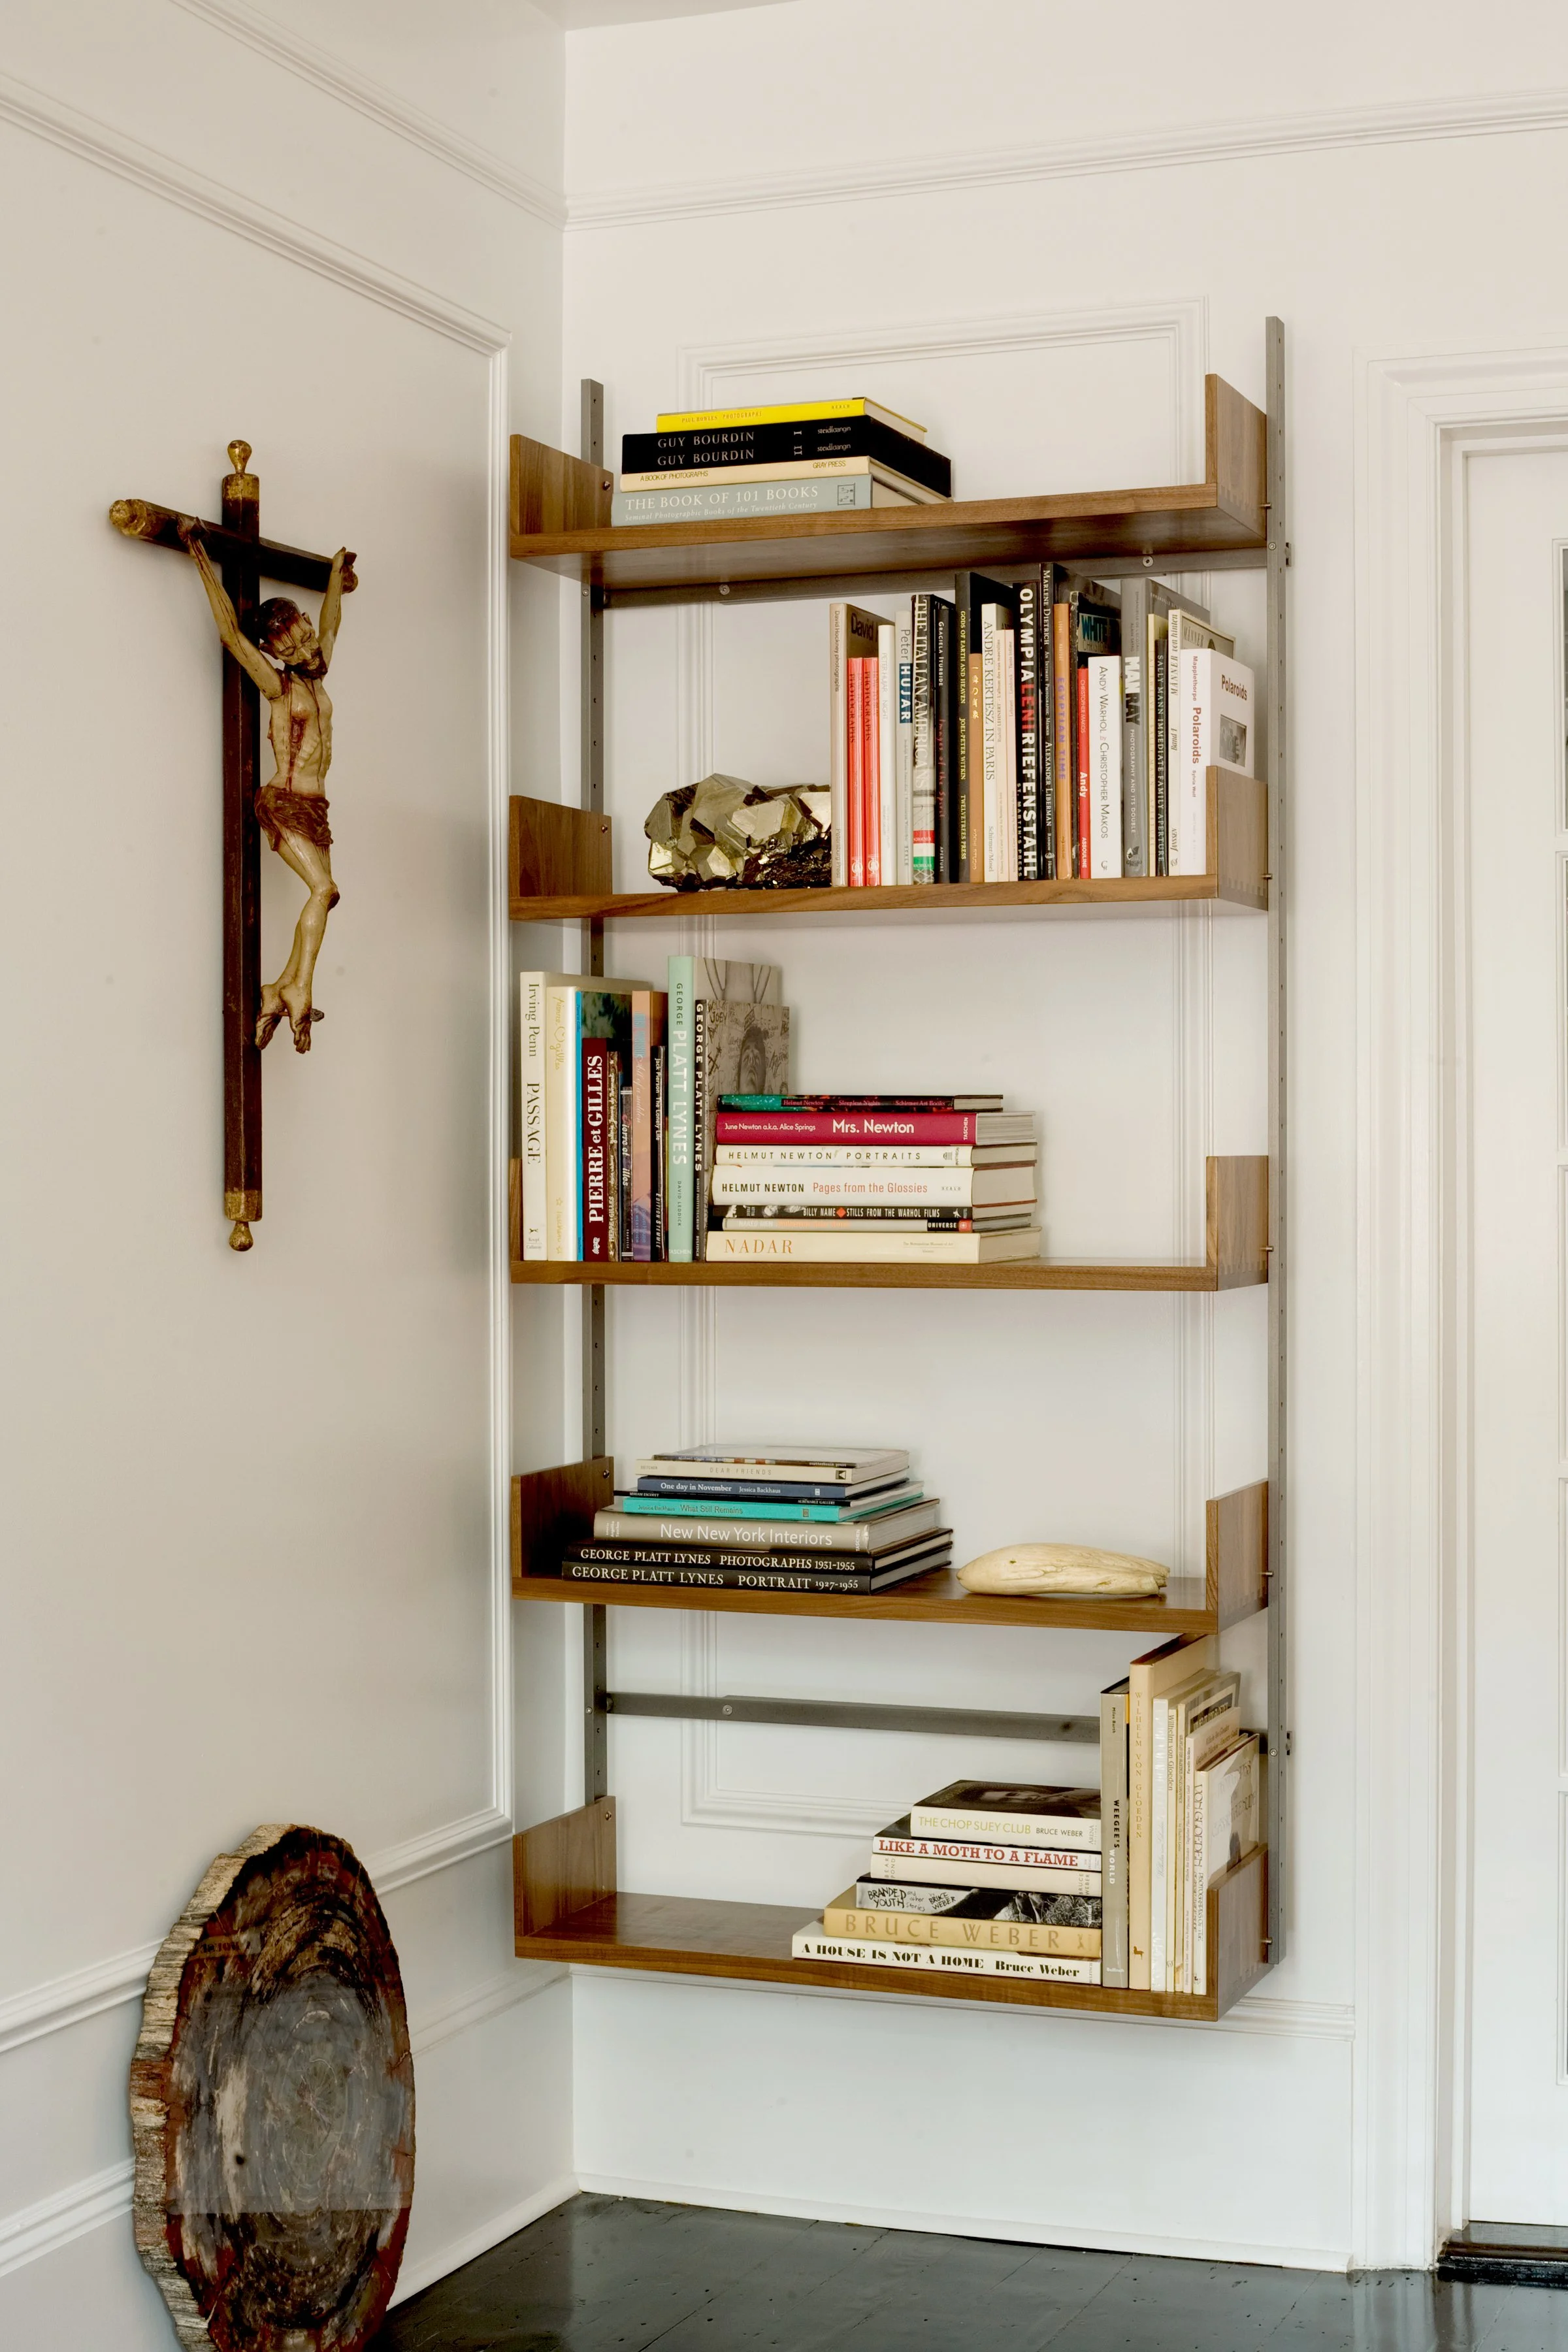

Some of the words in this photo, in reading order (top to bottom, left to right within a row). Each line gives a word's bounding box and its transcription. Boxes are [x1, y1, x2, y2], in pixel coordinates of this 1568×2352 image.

[657, 436, 685, 449] GUY
[693, 431, 755, 446] BOURDIN
[657, 454, 685, 466] GUY
[693, 449, 755, 463] BOURDIN
[669, 470, 708, 479] PHOTOGRAPHS
[625, 498, 655, 510] THE
[661, 494, 703, 508] BOOK
[710, 492, 729, 504] OF
[736, 491, 758, 502] 101
[767, 485, 818, 500] BOOKS
[851, 613, 874, 642] David
[915, 600, 928, 631] THE
[900, 629, 911, 660] Peter
[960, 630, 966, 639] OF
[1021, 589, 1034, 681] OLYMPIA
[915, 635, 928, 696] ITALIAN
[1099, 666, 1109, 691] ANDY
[1125, 657, 1140, 693] MAN
[901, 666, 911, 720] HUJAR
[1221, 674, 1247, 701] Polaroids
[1021, 683, 1036, 730] LENI
[1100, 694, 1109, 733] WARHOL
[1126, 693, 1140, 725] RAY
[915, 700, 928, 788] AMERICANS
[1192, 707, 1201, 764] Polaroids
[1080, 772, 1088, 798] Andy
[1100, 742, 1109, 801] CHRISTOPHER
[1022, 732, 1037, 876] RIEFENSTAHL
[1100, 804, 1109, 838] MAKOS
[525, 983, 541, 1021] Irving
[528, 1025, 541, 1057] Penn
[673, 1030, 687, 1092] PLATT
[587, 1056, 603, 1127] GILLES
[527, 1082, 541, 1165] PASSAGE
[593, 1130, 602, 1143] et
[672, 1102, 687, 1165] LYNES
[794, 1123, 816, 1133] Springs
[833, 1119, 860, 1134] Mrs.
[864, 1119, 915, 1134] Newton
[781, 1152, 832, 1160] NEWTON
[847, 1152, 921, 1160] PORTRAITS
[588, 1146, 604, 1223] PIERRE
[722, 1183, 760, 1192] HELMUT
[764, 1183, 804, 1193] NEWTON
[813, 1183, 841, 1195] Pages
[844, 1182, 866, 1193] from
[868, 1182, 884, 1193] the
[887, 1182, 928, 1194] Glossies
[803, 1207, 818, 1217] BILLY
[820, 1207, 836, 1217] NAME
[846, 1207, 864, 1217] STILLS
[866, 1207, 882, 1217] FROM
[885, 1208, 895, 1217] THE
[898, 1208, 922, 1218] WARHOL
[924, 1208, 940, 1218] FILMS
[724, 1239, 793, 1254] NADAR
[676, 1482, 688, 1492] day
[661, 1524, 693, 1539] New
[697, 1526, 730, 1541] New
[734, 1526, 766, 1543] York
[770, 1528, 833, 1546] Interiors
[580, 1548, 630, 1561] GEORGE
[634, 1551, 672, 1563] PLATT
[674, 1553, 711, 1565] LYNES
[719, 1555, 811, 1569] PHOTOGRAPHS
[814, 1560, 855, 1571] 1931-1955
[572, 1566, 629, 1580] GEORGE
[632, 1569, 675, 1582] PLATT
[679, 1572, 724, 1585] LYNES
[737, 1575, 811, 1590] PORTRAIT
[815, 1579, 858, 1592] 1927-1955
[918, 1816, 939, 1827] THE
[940, 1818, 972, 1830] CHOP
[973, 1820, 1001, 1833] SUEY
[1003, 1823, 1031, 1835] CLUB
[1061, 1829, 1083, 1837] WEBER
[879, 1840, 915, 1854] LIKE
[919, 1843, 929, 1854] A
[932, 1844, 981, 1859] MOTH
[984, 1848, 1005, 1860] TO
[1009, 1850, 1020, 1862] A
[1024, 1852, 1078, 1867] FLAME
[868, 1887, 907, 1900] BRANDED
[874, 1898, 905, 1908] YOUTH
[928, 1892, 949, 1904] BRUCE
[932, 1896, 956, 1910] WEBER
[845, 1914, 939, 1939] BRUCE
[962, 1923, 1060, 1948] WEBER
[802, 1943, 810, 1953] A
[817, 1944, 866, 1958] HOUSE
[872, 1949, 887, 1960] IS
[892, 1951, 921, 1963] NOT
[926, 1954, 935, 1964] A
[941, 1955, 984, 1968] HOME
[995, 1960, 1034, 1973] Bruce
[1039, 1964, 1080, 1977] Weber
